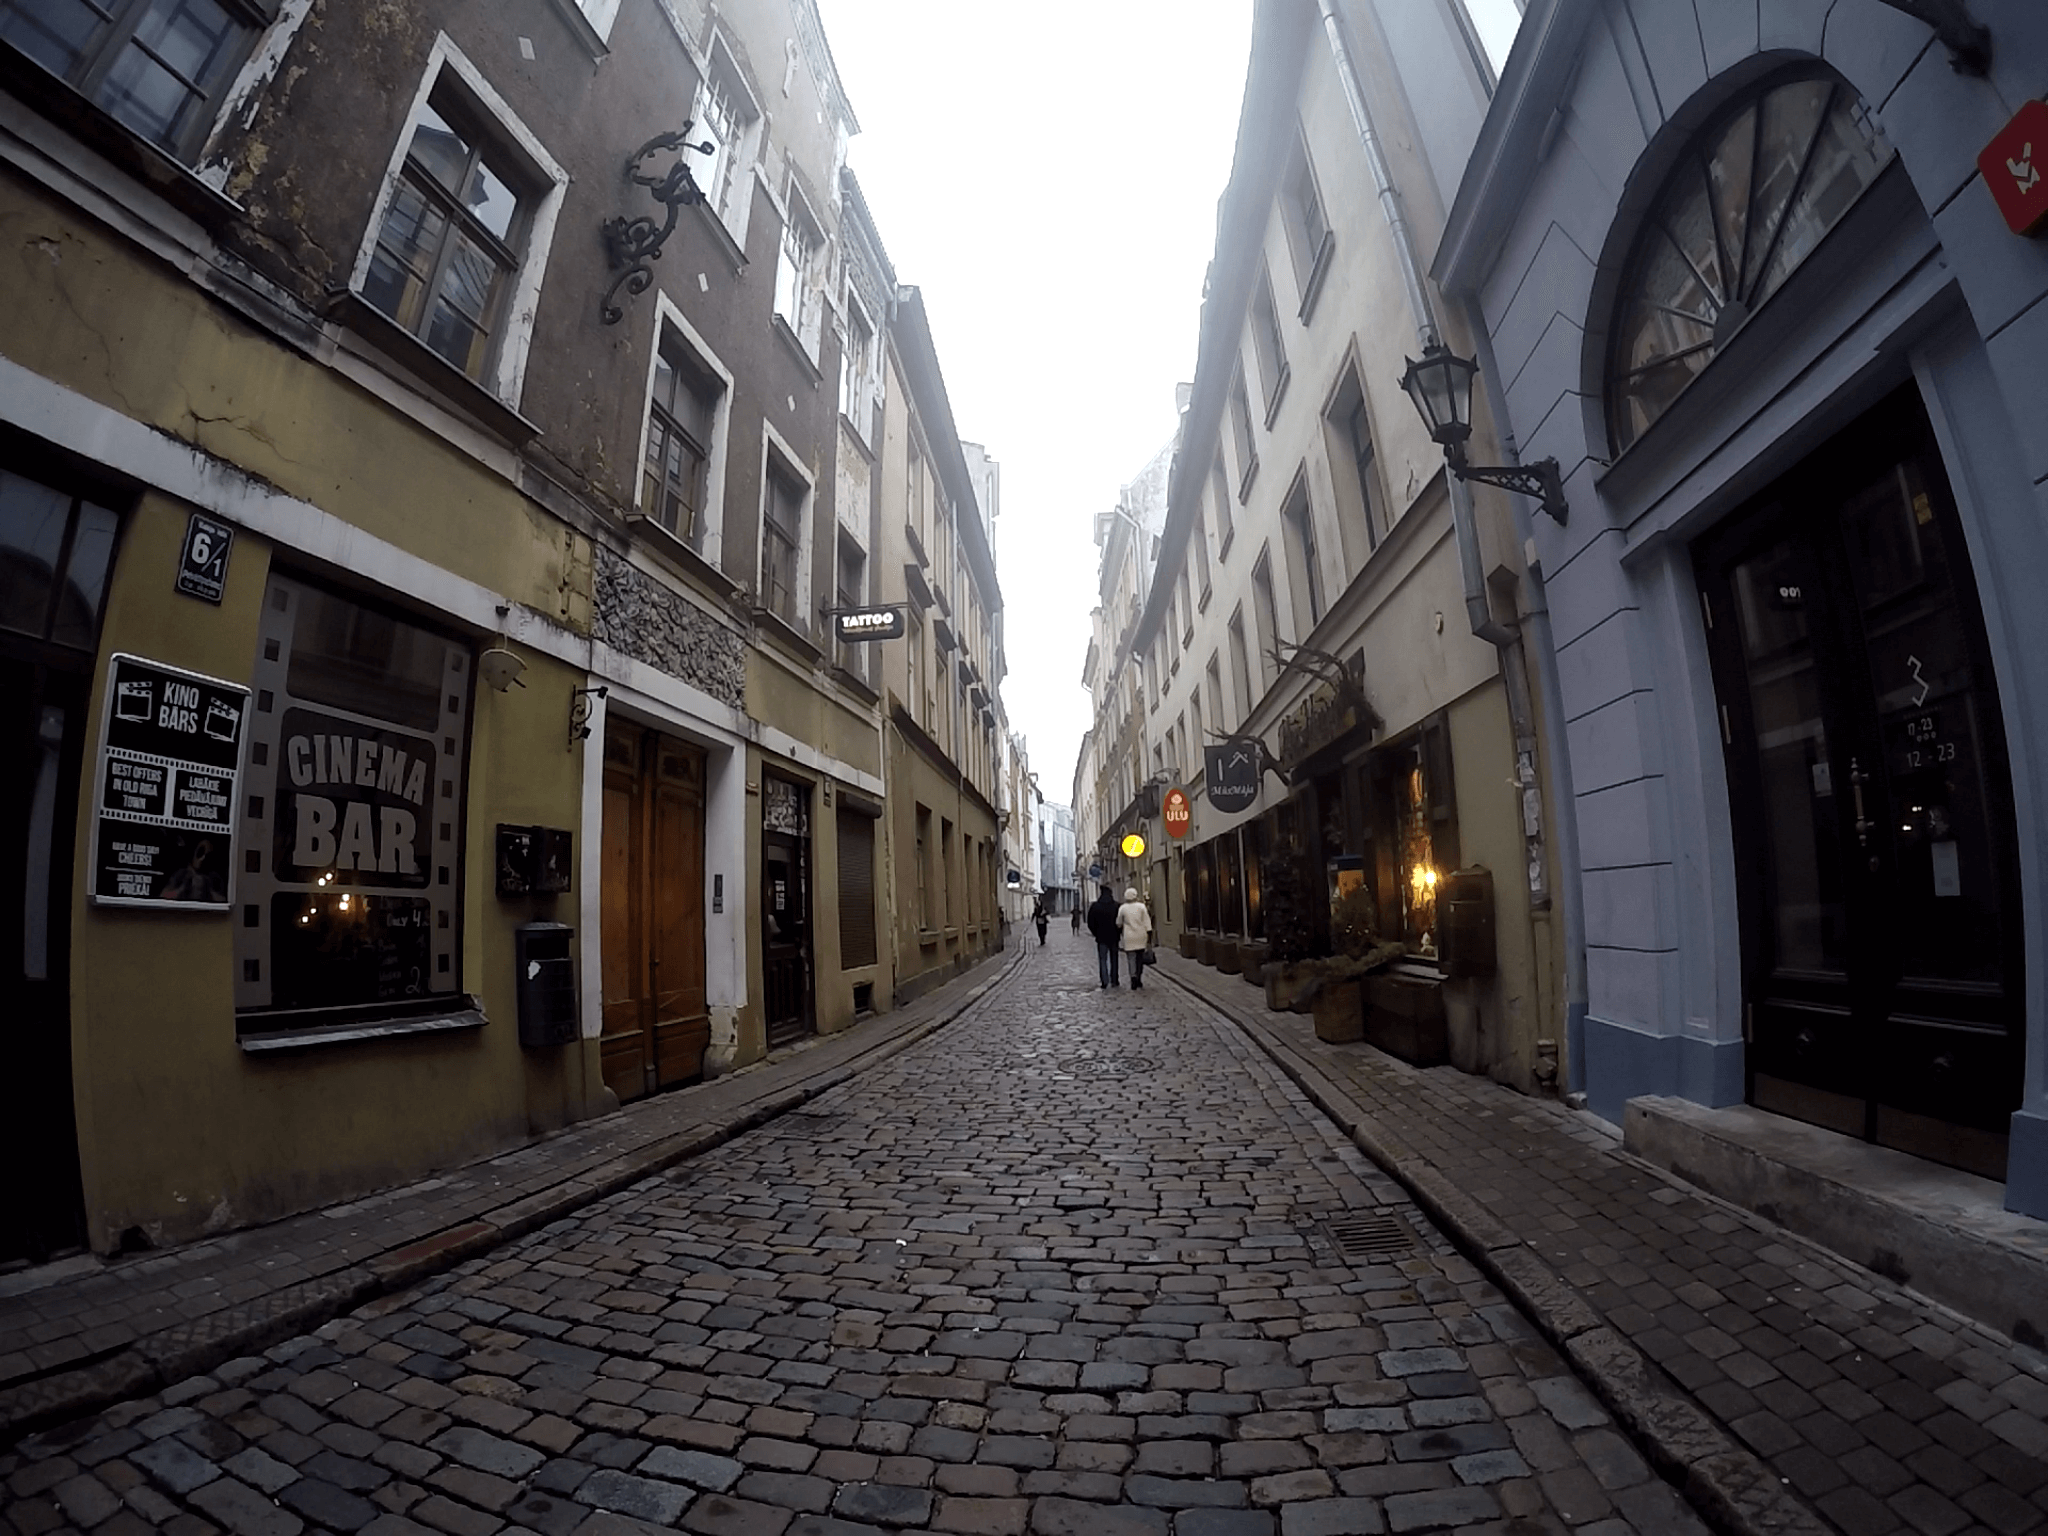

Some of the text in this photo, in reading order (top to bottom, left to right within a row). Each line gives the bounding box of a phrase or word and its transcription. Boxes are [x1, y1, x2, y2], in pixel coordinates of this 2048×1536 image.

[842, 612, 894, 627] TATTOO
[163, 681, 199, 709] KINO
[1907, 750, 1921, 768] 12
[1937, 742, 1955, 762] 23
[112, 762, 132, 778] BEST
[287, 734, 427, 806] CINEMA
[123, 780, 139, 793] OLD
[123, 794, 146, 809] TOWN
[1166, 810, 1189, 822] ULU
[292, 793, 418, 875] BAR
